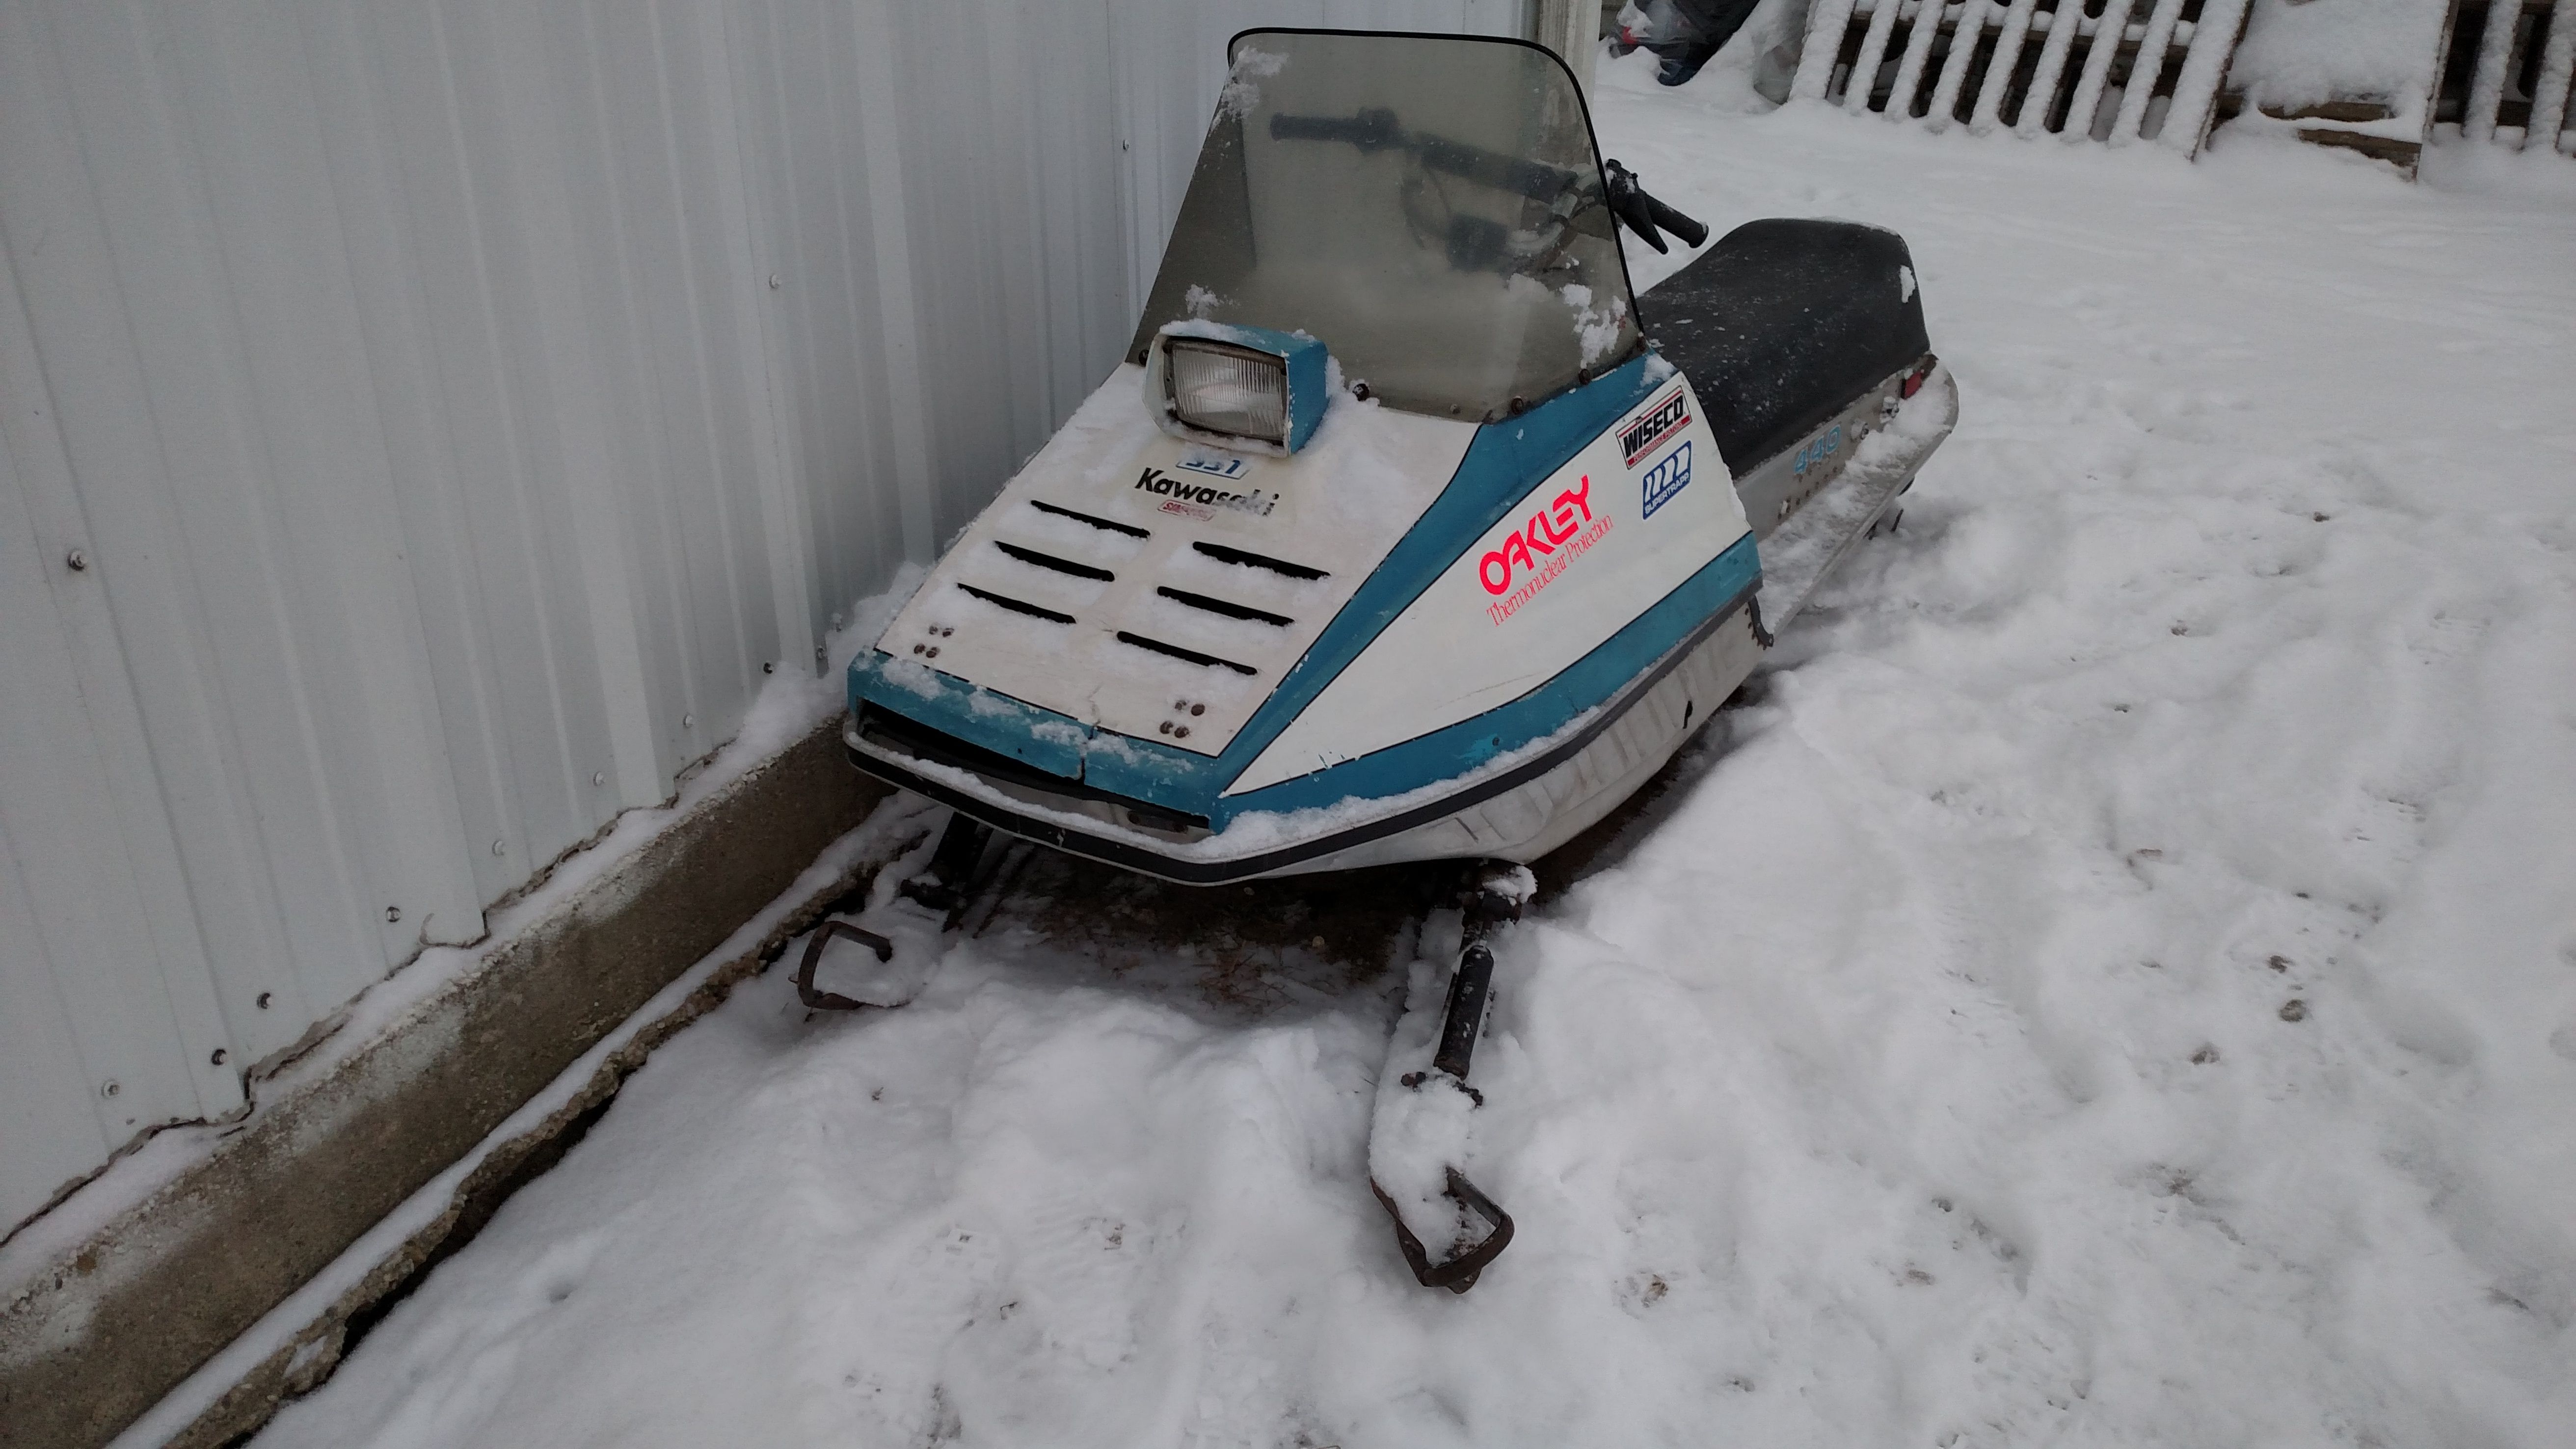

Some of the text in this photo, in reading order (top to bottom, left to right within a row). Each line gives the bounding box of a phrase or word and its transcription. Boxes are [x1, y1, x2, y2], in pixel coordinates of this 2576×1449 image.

[1623, 395, 1684, 458] WISECO
[1794, 425, 1841, 475] 440
[1134, 467, 1279, 517] Kawai
[1645, 472, 1689, 515] SUPERTRAPP
[1479, 474, 1592, 595] OAKLEY
[1486, 514, 1614, 627] Thermonuclear Protection
